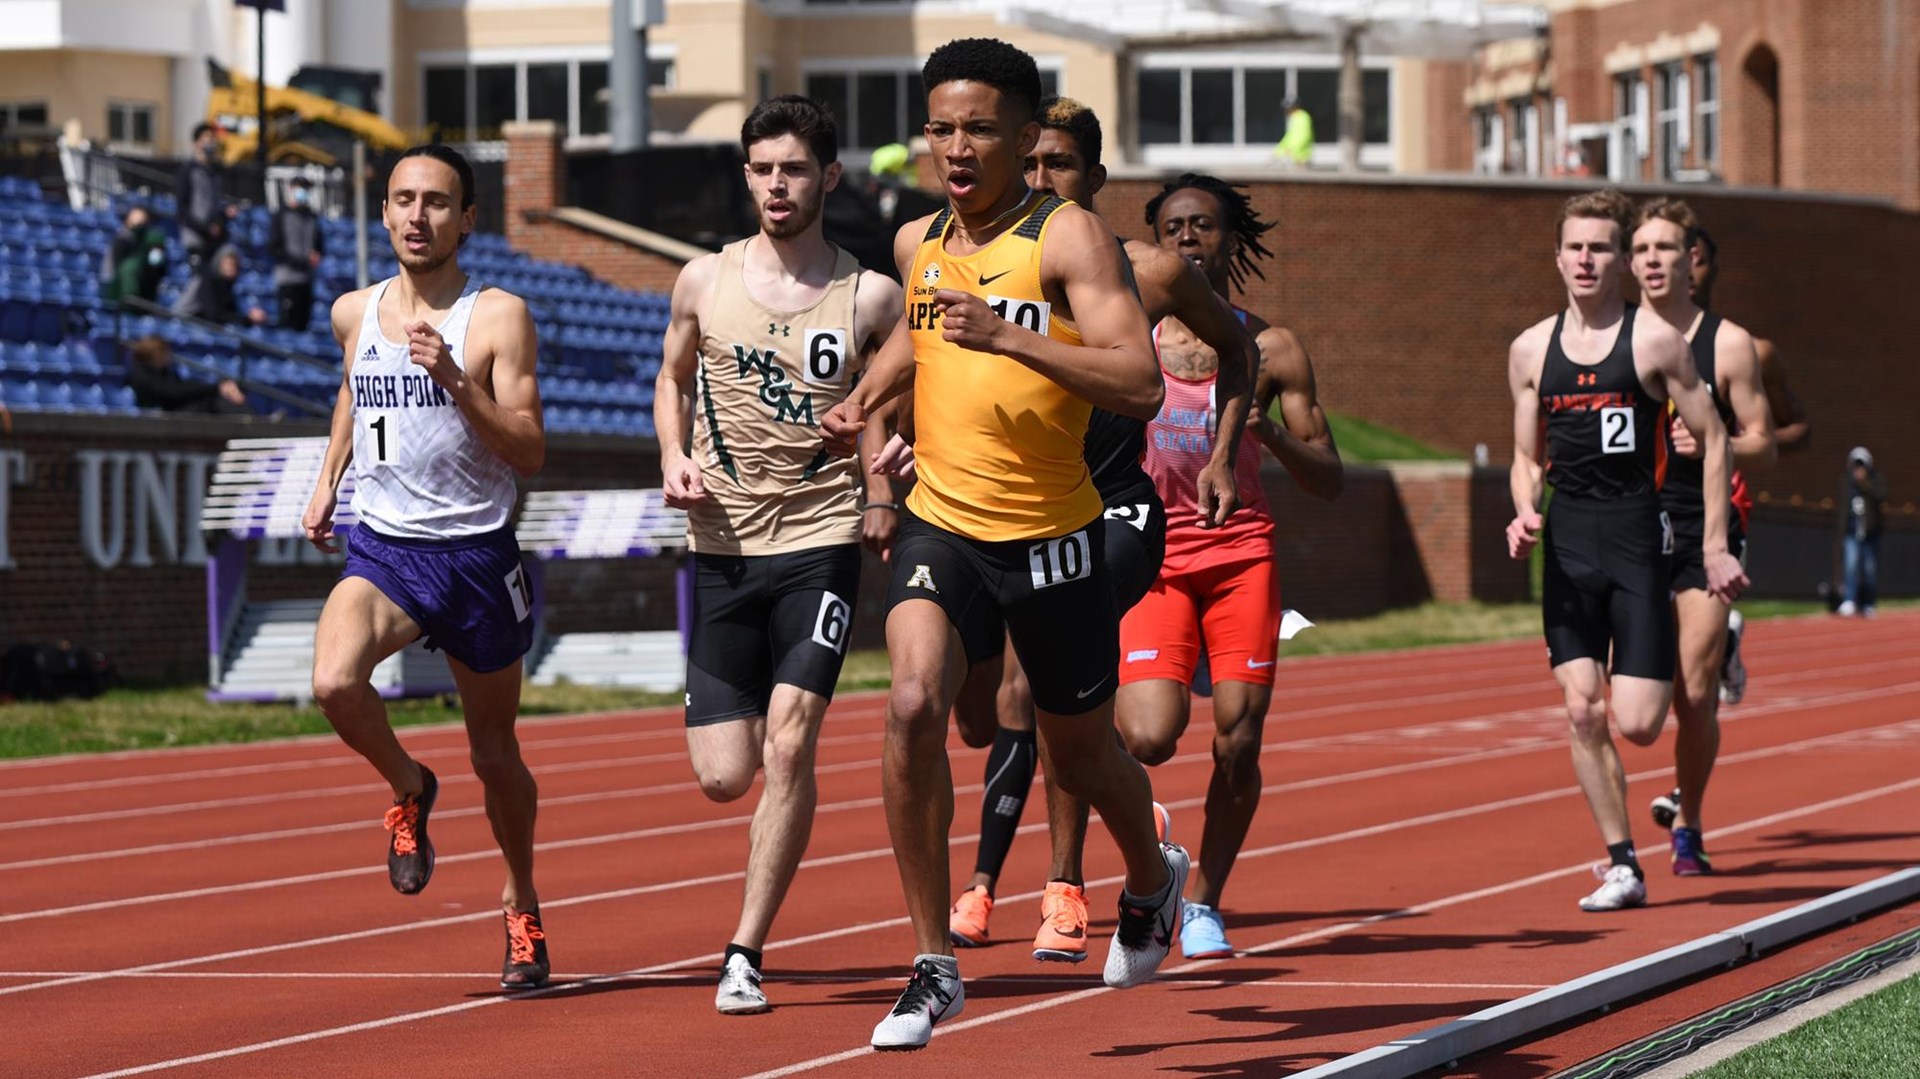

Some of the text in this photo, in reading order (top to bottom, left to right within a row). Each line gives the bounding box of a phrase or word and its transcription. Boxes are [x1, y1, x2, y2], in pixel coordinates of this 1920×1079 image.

[908, 302, 941, 330] APP
[809, 332, 839, 380] 6
[355, 374, 457, 408] HIGH POIN
[732, 344, 819, 427] W&M
[370, 415, 386, 461] 1
[1606, 412, 1630, 448] 2
[1033, 536, 1083, 585] 10
[511, 569, 529, 612] 1
[821, 599, 846, 647] 6
